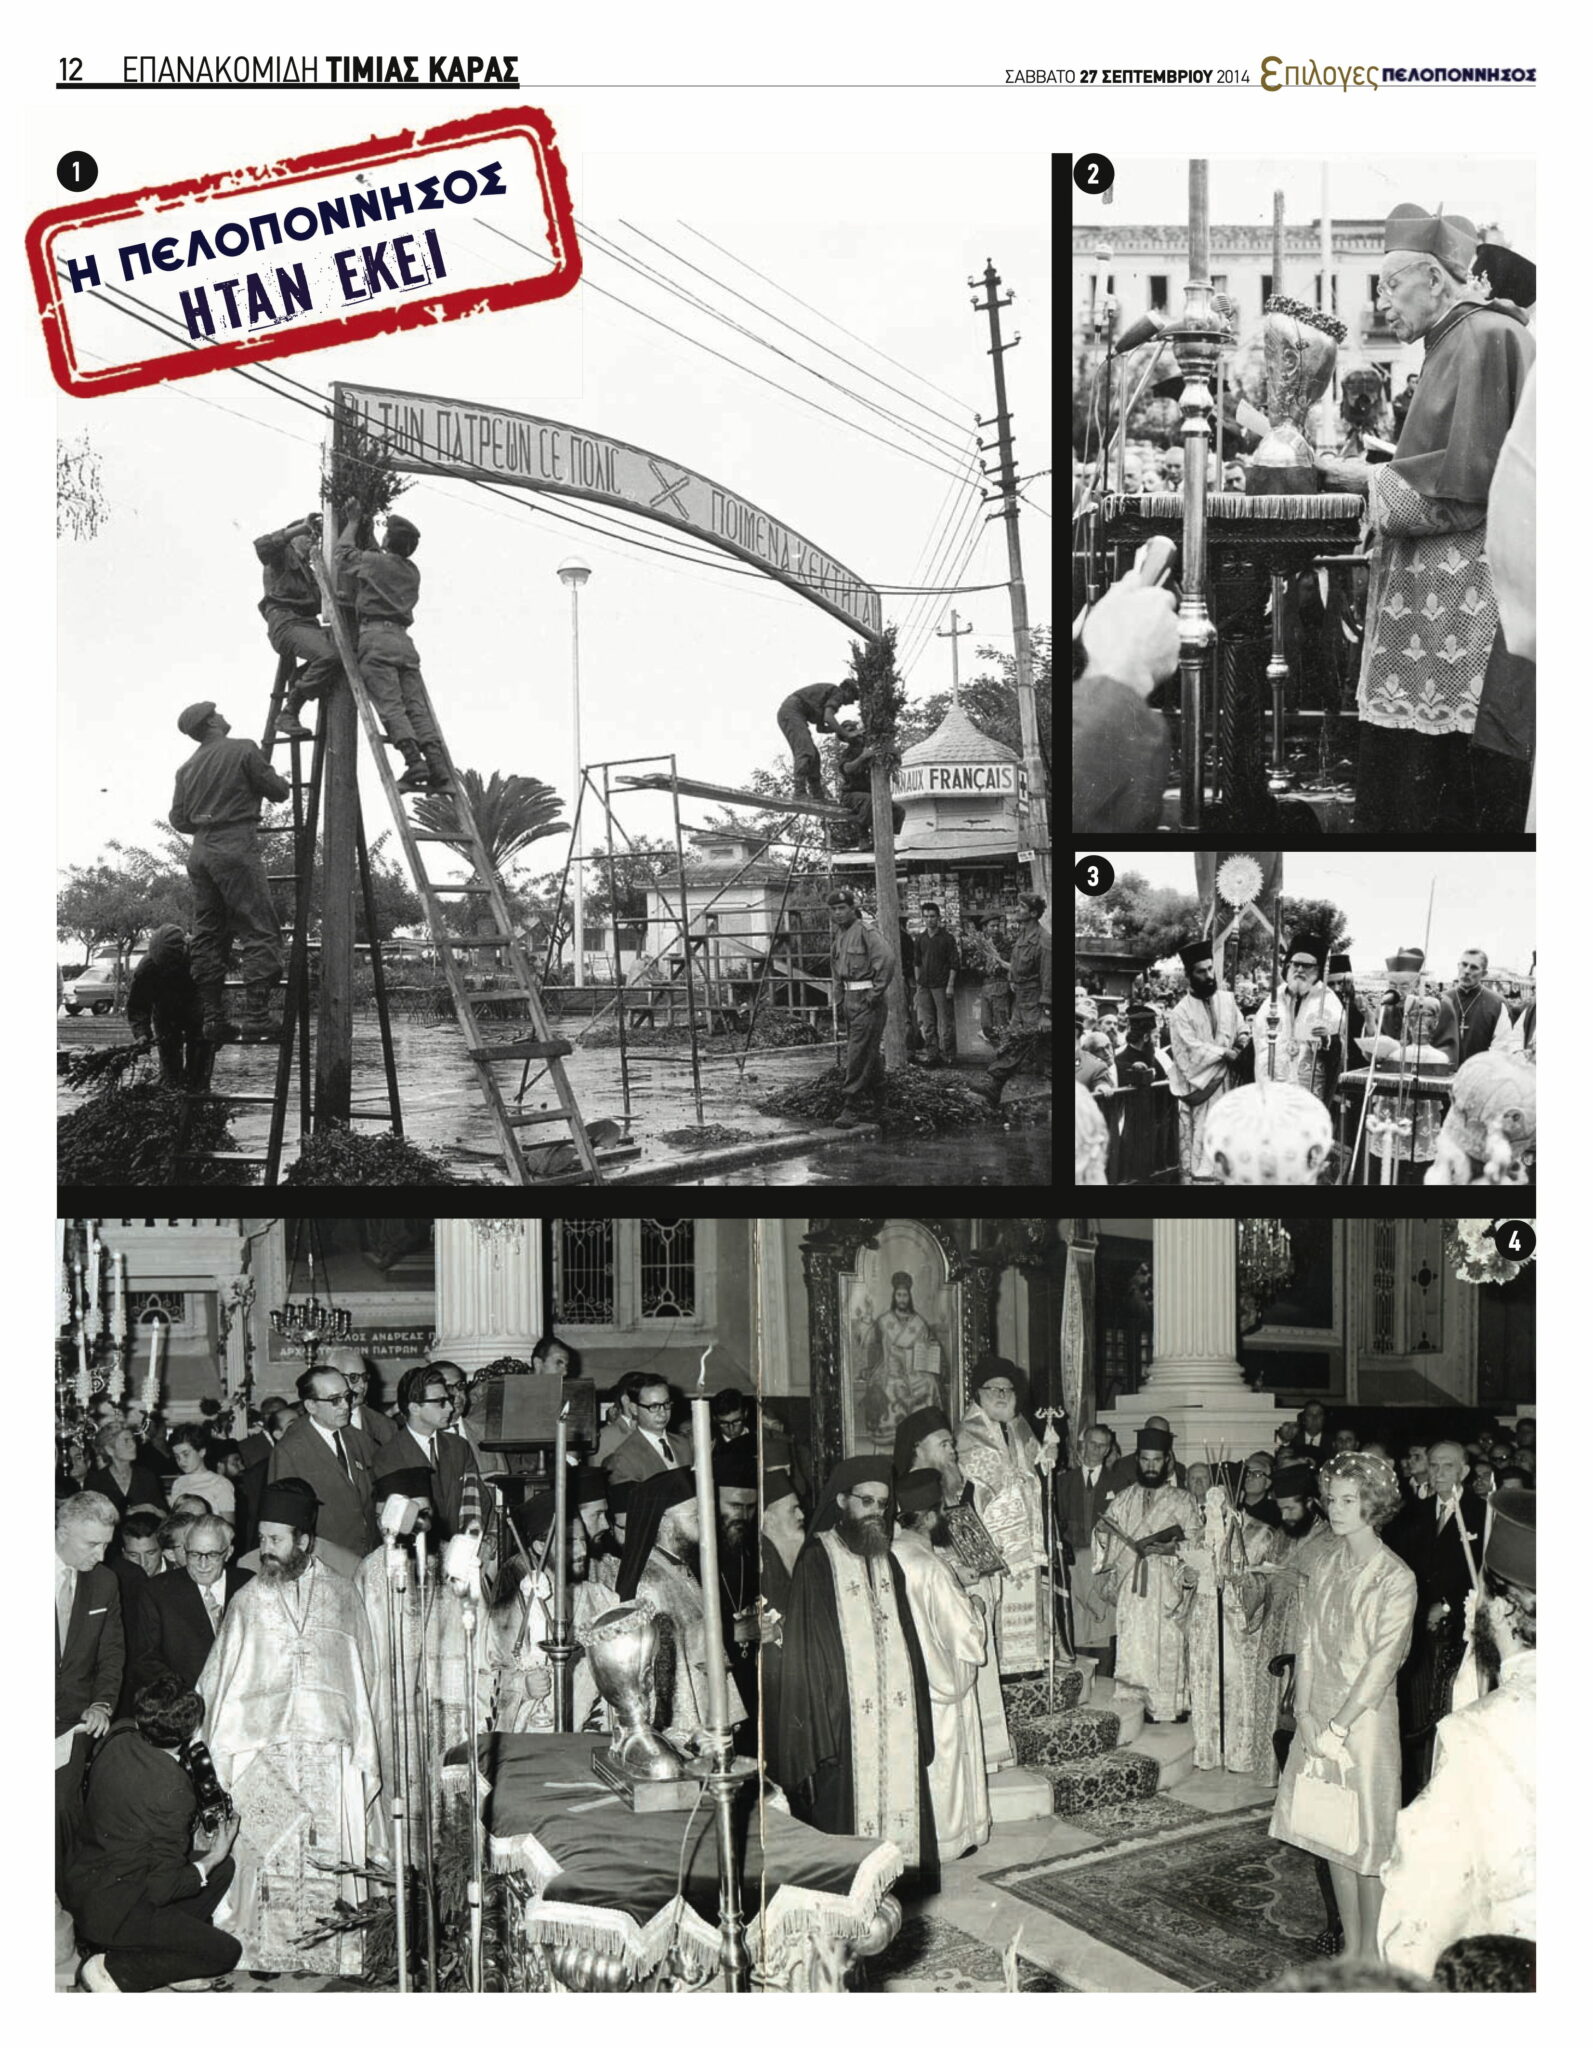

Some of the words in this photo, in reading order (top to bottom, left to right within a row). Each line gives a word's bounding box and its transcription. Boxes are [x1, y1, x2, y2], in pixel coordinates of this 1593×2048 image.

[59, 56, 83, 82] 12
[123, 56, 318, 83] ΕΠΑΝΑΚΟΜΙΔΗ
[326, 56, 419, 83] ΤΙΜΙΑΣ
[430, 56, 519, 83] ΚΑΡΑΣ
[1005, 69, 1076, 84] ΣΑΒΒΑΤΟ
[1080, 69, 1098, 84] 27
[1102, 69, 1214, 84] ΣΕΠΤΕΜΒΡΙΟΥ
[1217, 69, 1250, 84] 2014
[929, 767, 1013, 792] FRANÇAIS
